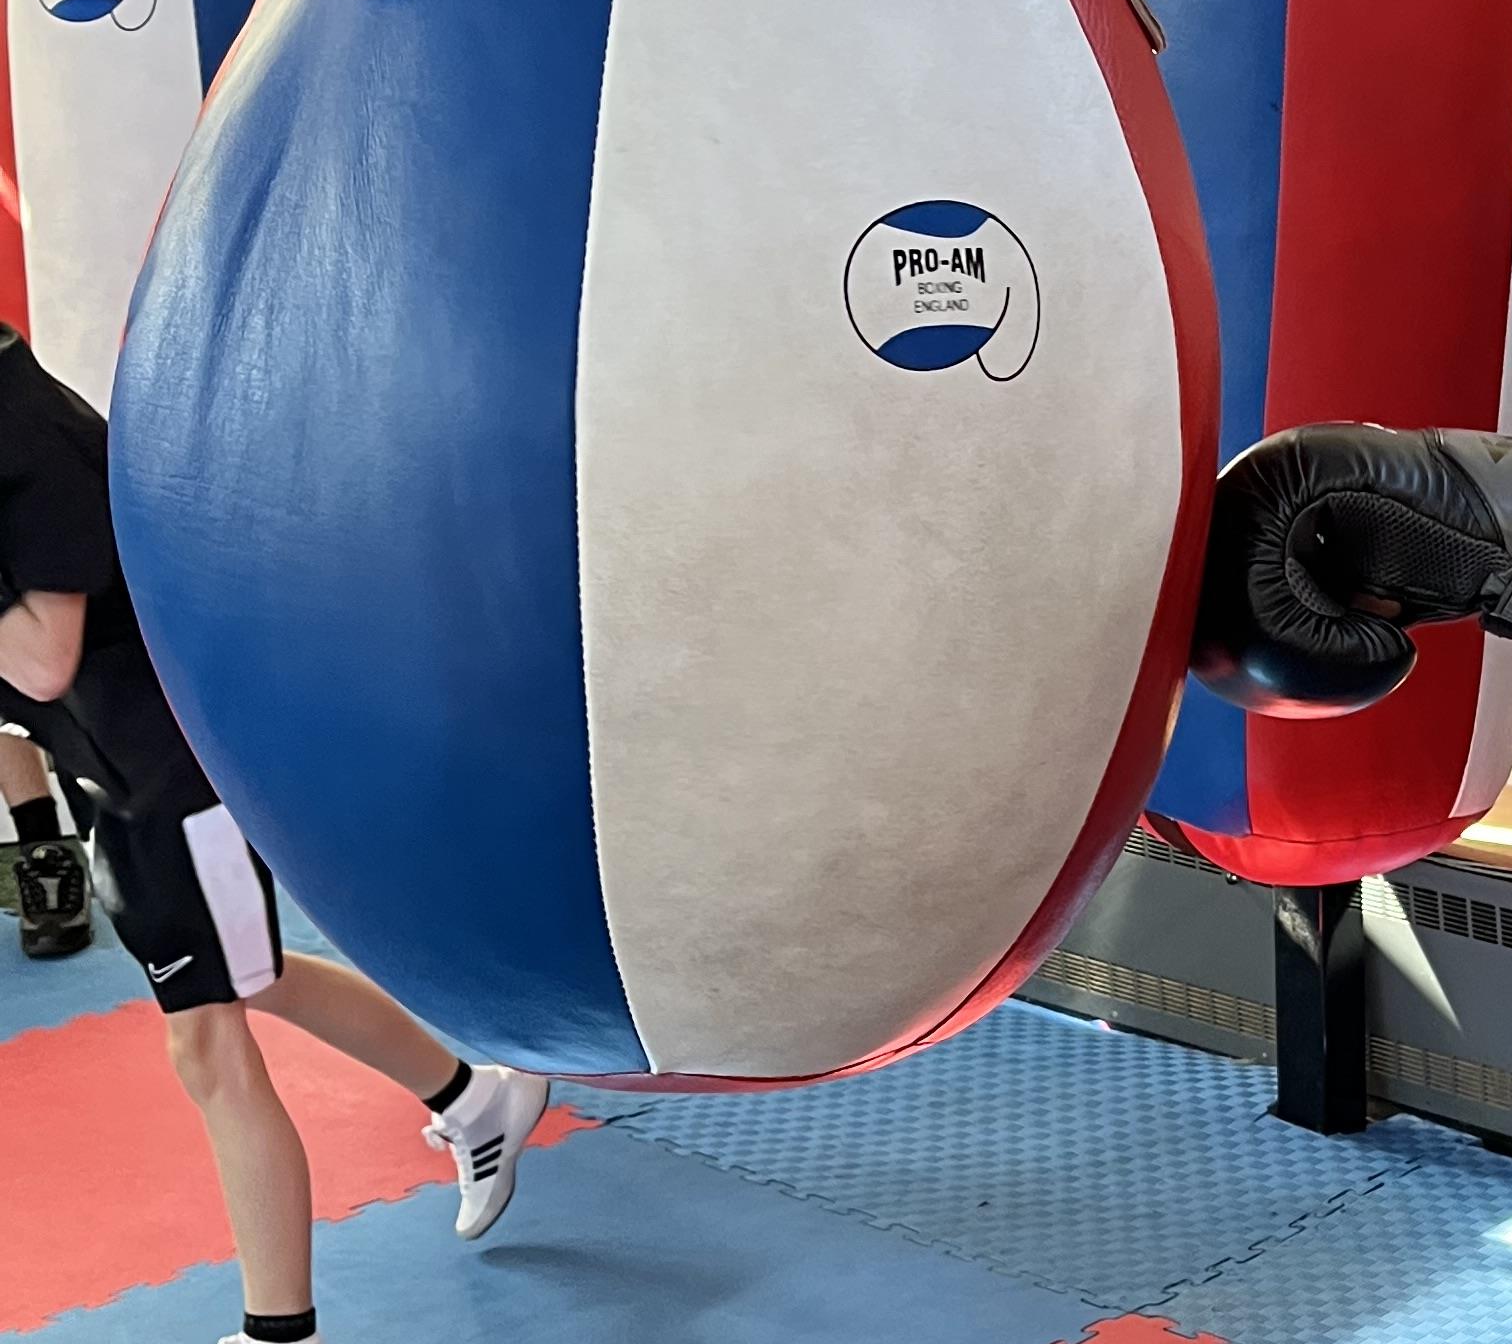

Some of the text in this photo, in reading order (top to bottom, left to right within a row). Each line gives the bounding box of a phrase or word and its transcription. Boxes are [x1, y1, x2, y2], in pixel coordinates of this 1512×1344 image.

[892, 246, 986, 286] PRO-AM
[917, 280, 963, 295] BOXING
[913, 298, 970, 314] ENGLAND
